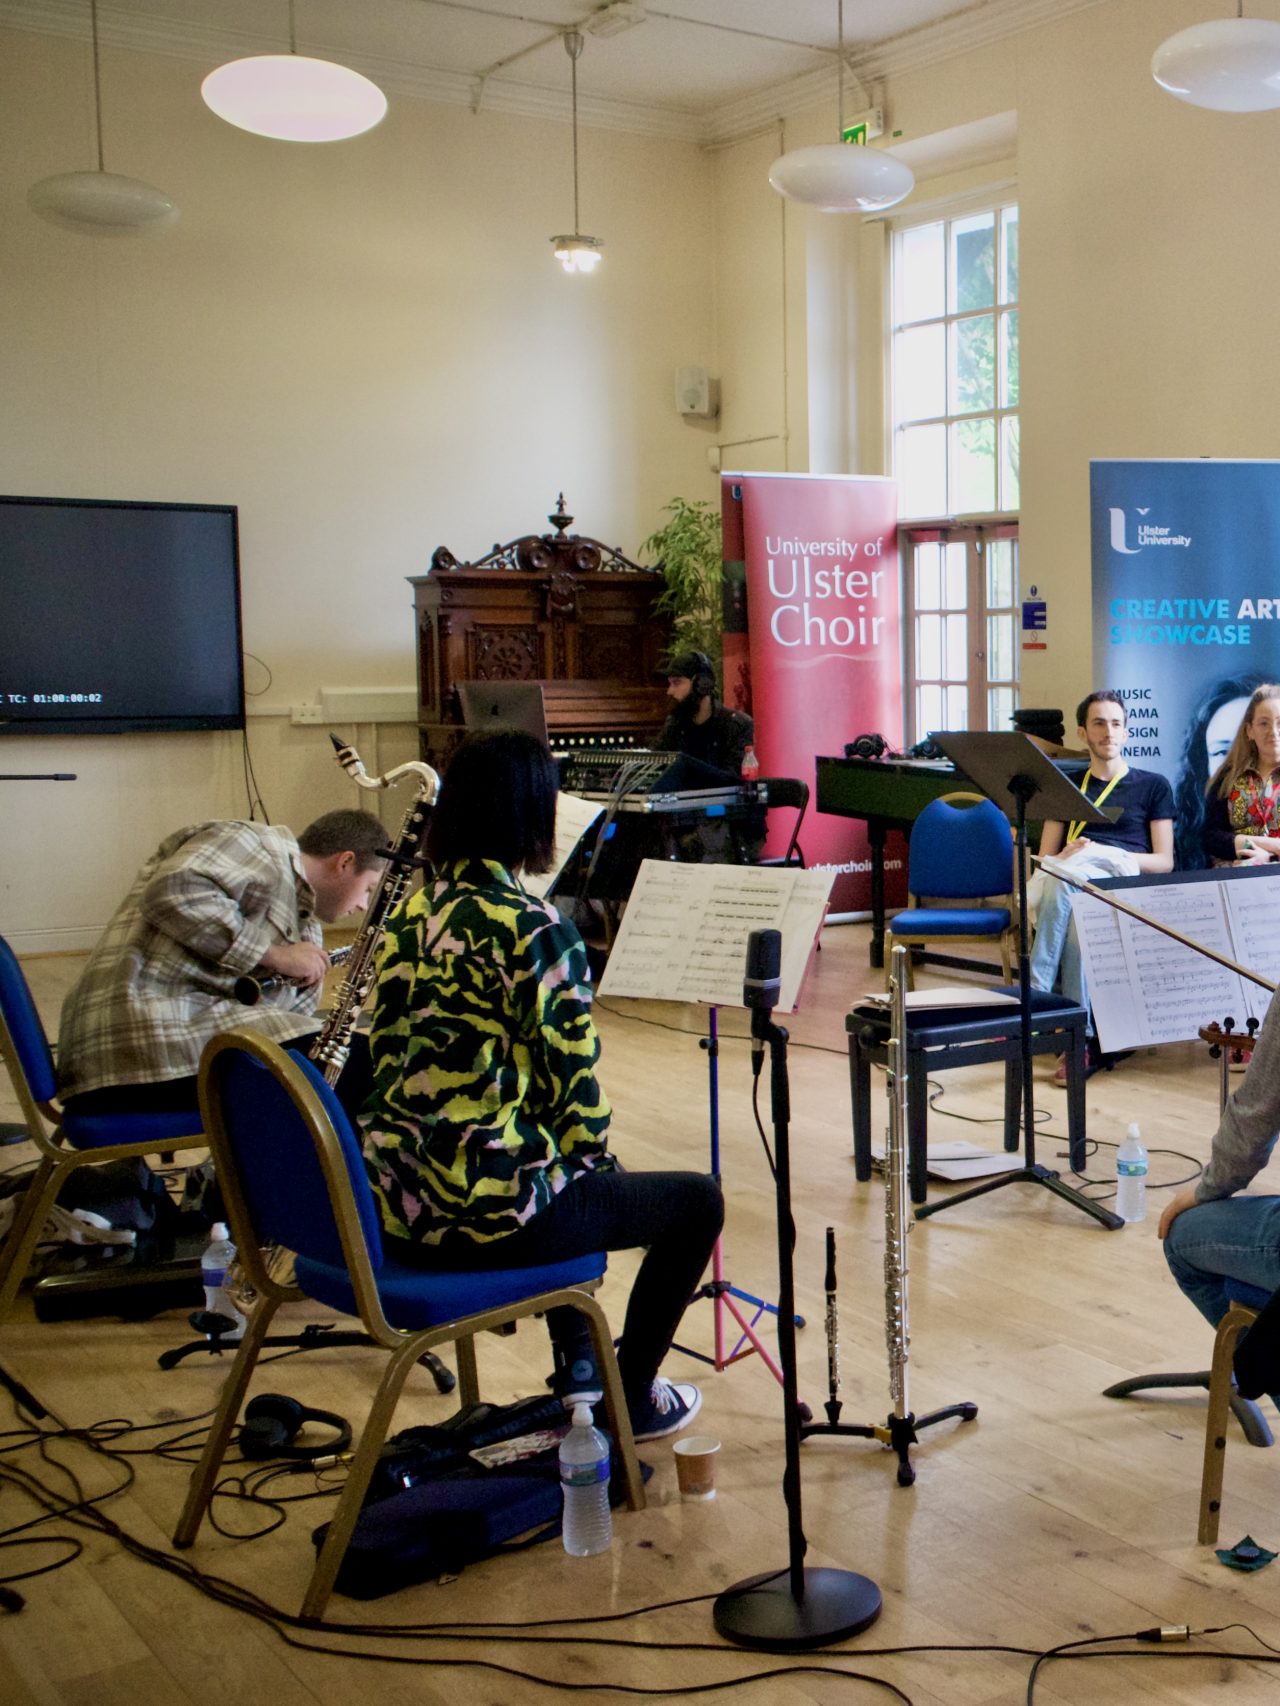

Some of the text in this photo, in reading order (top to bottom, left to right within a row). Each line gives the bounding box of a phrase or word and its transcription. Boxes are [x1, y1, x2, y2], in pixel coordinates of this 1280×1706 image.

[1137, 525, 1170, 536] Ulster
[765, 536, 883, 562] University of
[1137, 535, 1192, 547] University
[767, 556, 885, 598] Ulster
[1109, 599, 1229, 619] CREATIVE
[770, 602, 886, 647] Choir
[1110, 624, 1250, 645] SHOWCASE
[1128, 707, 1159, 719] AMA
[1128, 727, 1159, 738] SIGN
[1120, 746, 1161, 757] NEMA
